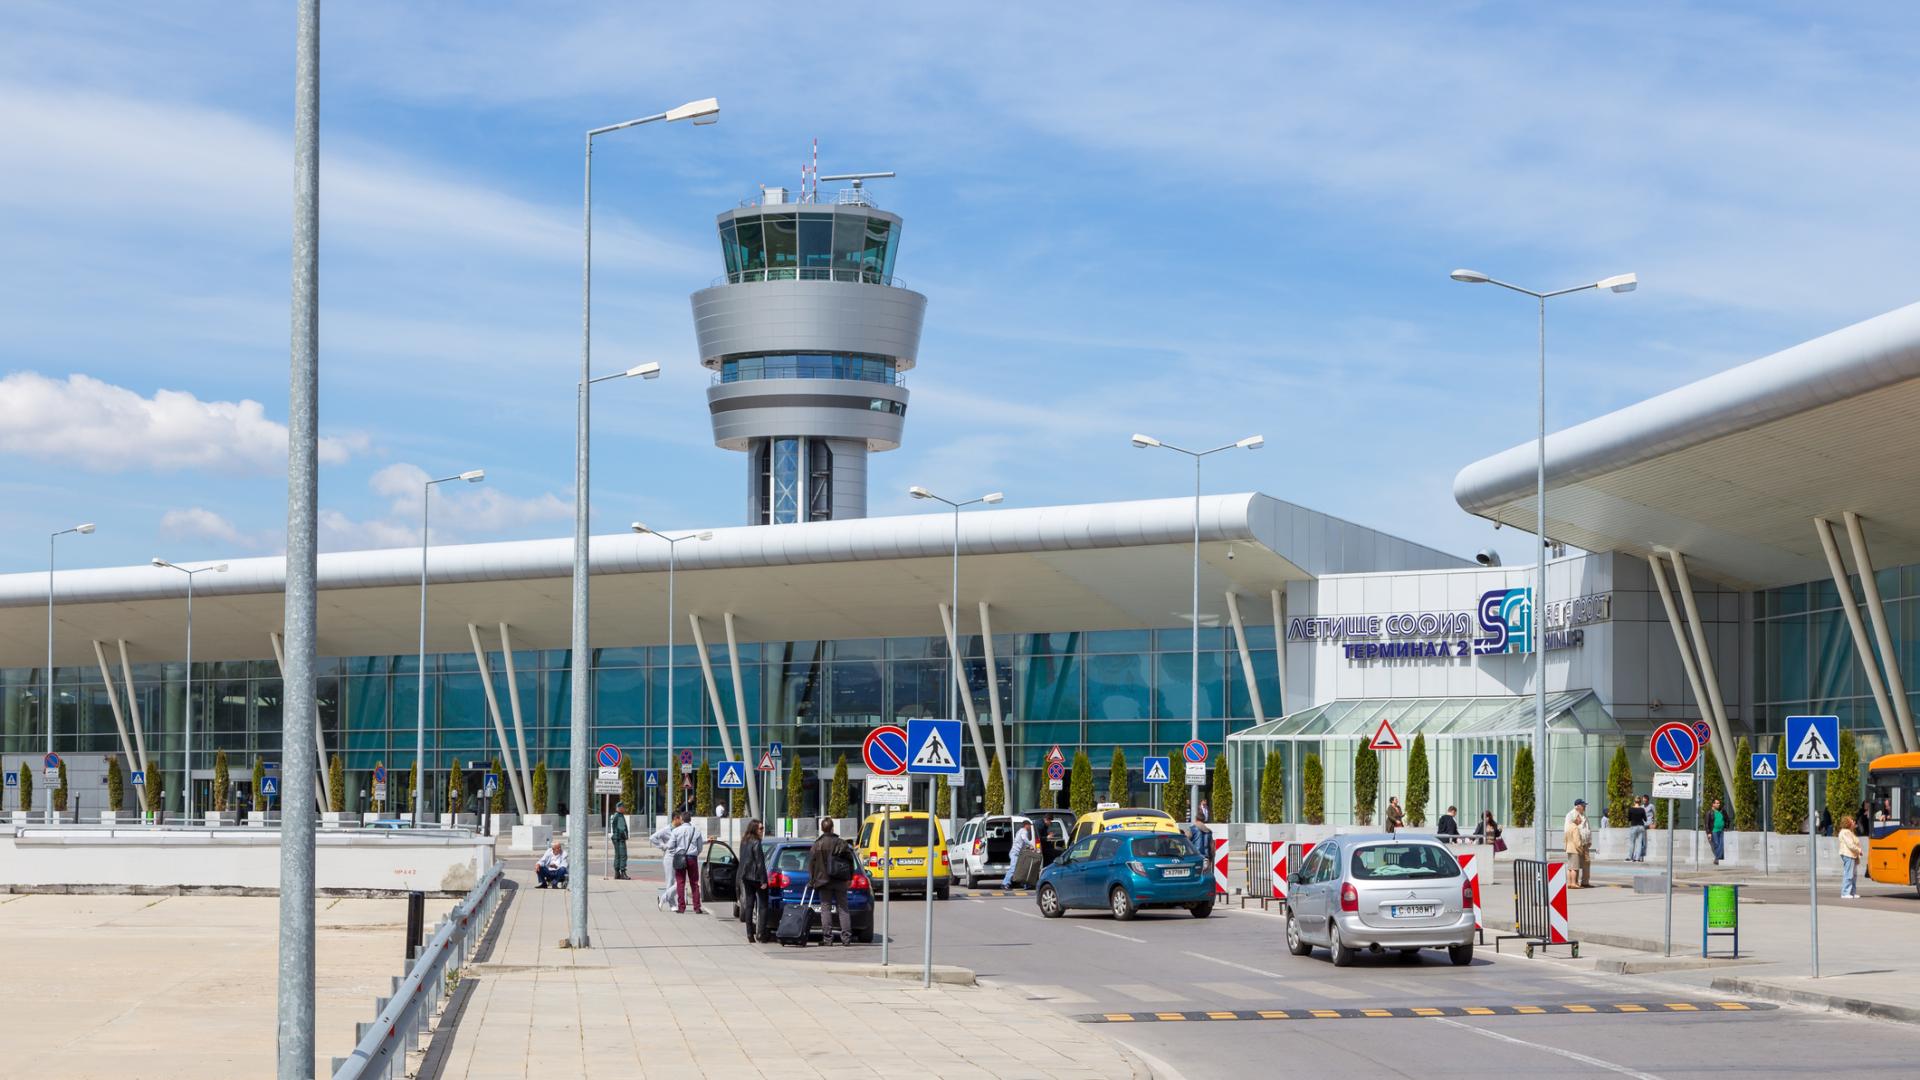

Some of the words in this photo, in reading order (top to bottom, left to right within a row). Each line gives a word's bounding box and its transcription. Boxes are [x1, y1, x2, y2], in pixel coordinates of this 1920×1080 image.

[1288, 615, 1379, 640] ЛЕТИЩЕ
[1386, 613, 1472, 636] СОФИЯ
[1342, 641, 1450, 659] ТЕРМИНАЛ
[1457, 640, 1468, 656] 2
